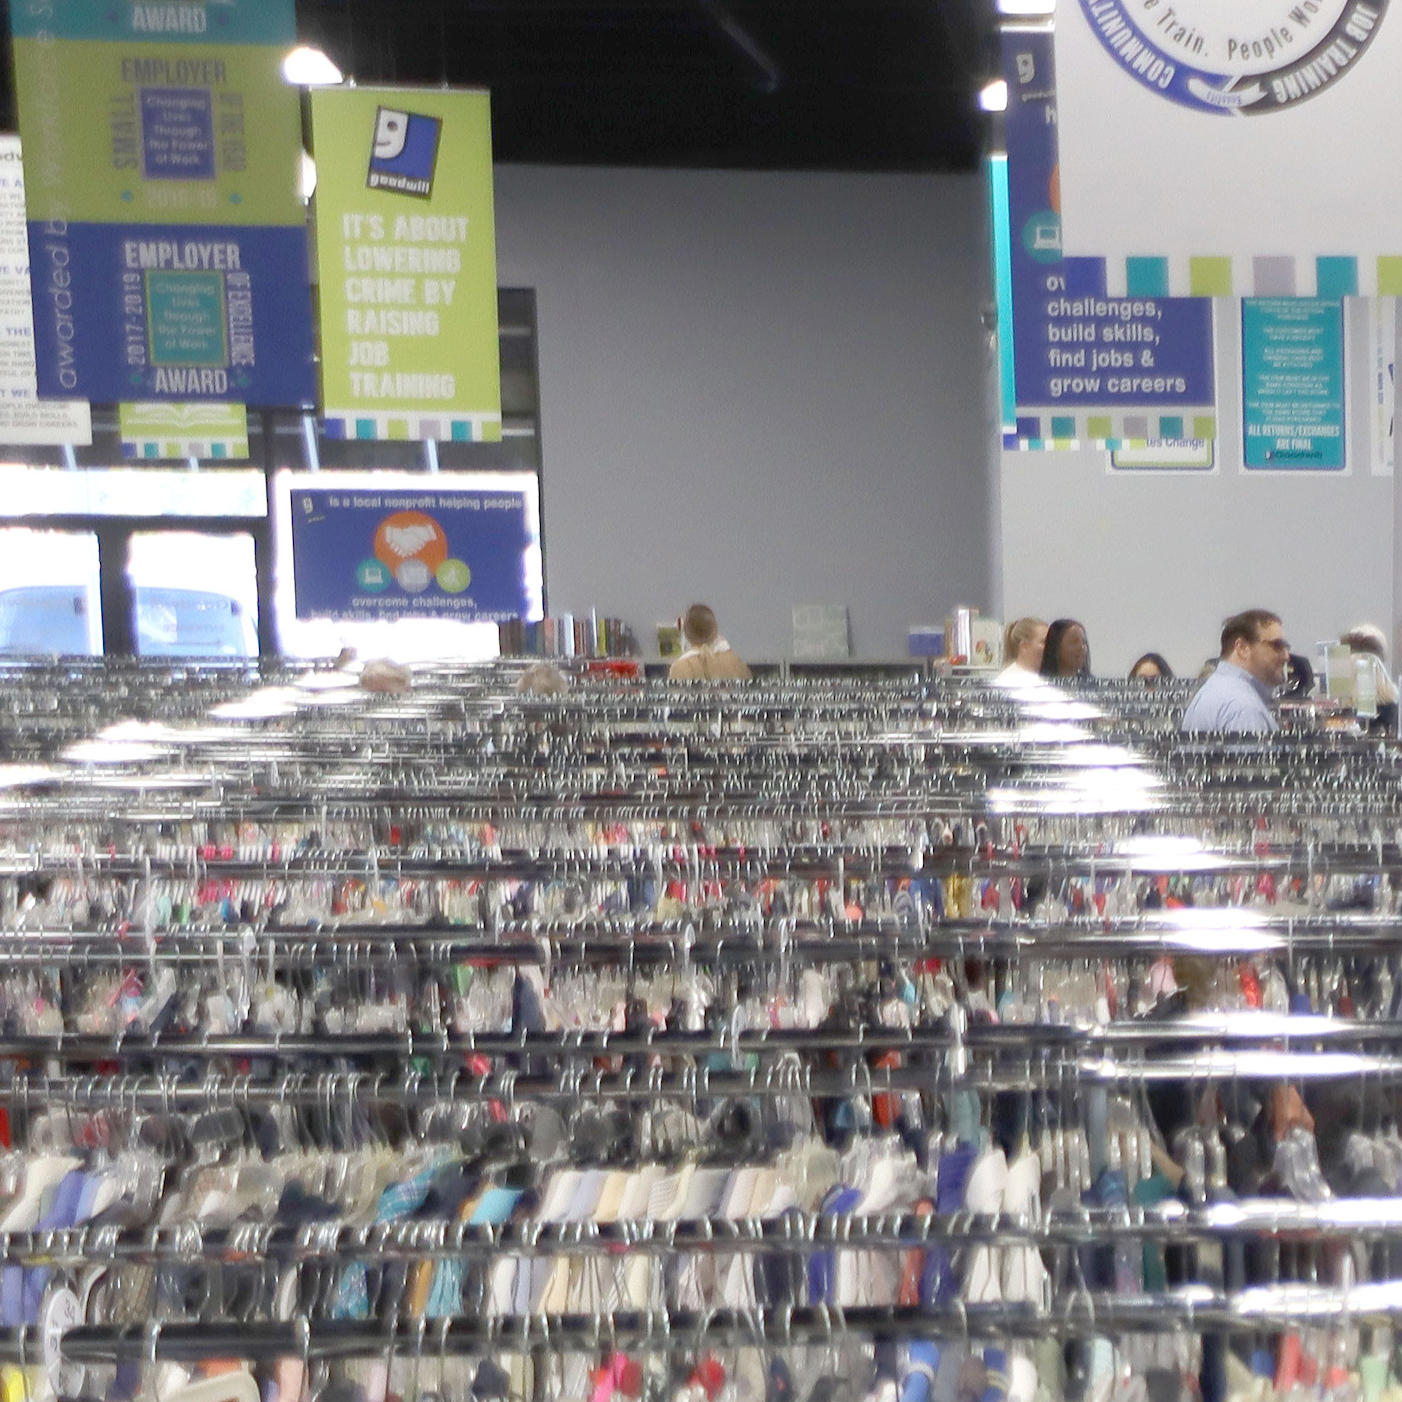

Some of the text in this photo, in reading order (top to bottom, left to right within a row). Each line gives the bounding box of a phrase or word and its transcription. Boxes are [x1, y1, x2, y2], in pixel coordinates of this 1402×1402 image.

[131, 4, 208, 33] AWARD
[1088, 0, 1175, 89] COMMUNIT
[1228, 26, 1294, 60] People
[1272, 4, 1378, 104] JOB TRAINING
[120, 57, 227, 83] EMPLOYER
[368, 172, 431, 195] goodwill
[342, 213, 469, 242] IT'S ABOUT
[124, 241, 241, 269] EMPLOYER
[343, 247, 462, 274] LOWERING
[344, 279, 457, 305] CRIME BY
[45, 244, 78, 390] awarded
[346, 309, 440, 336] RAISING
[1047, 299, 1163, 321] challenges,
[1048, 323, 1160, 346] build skills,
[348, 340, 389, 367] JOB
[1048, 349, 1155, 371] find jobs &
[154, 368, 229, 394] AWARD
[350, 372, 456, 399] TRAINING
[1050, 376, 1187, 398] grow careers
[328, 496, 522, 511] is a local nonprofit helping people
[351, 596, 478, 610] overcome challenges,
